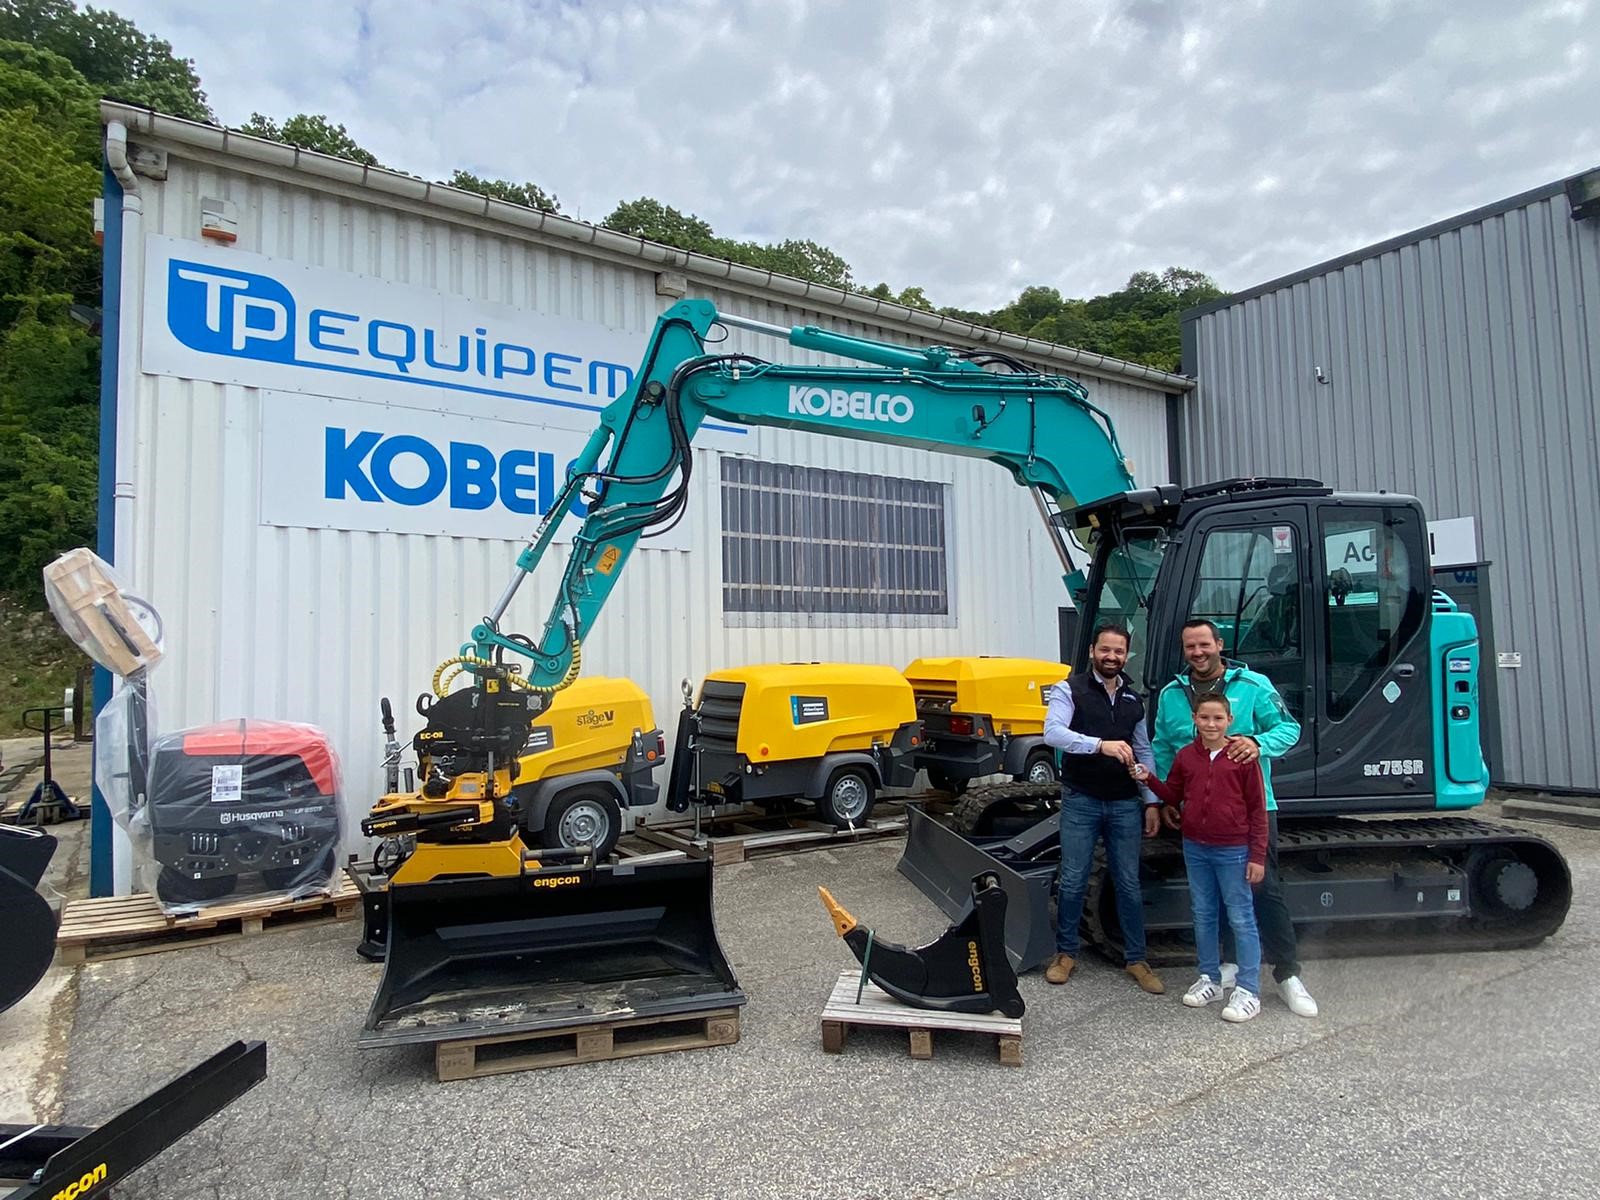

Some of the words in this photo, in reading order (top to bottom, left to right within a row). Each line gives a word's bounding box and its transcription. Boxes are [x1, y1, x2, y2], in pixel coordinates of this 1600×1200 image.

[177, 267, 289, 350] TP
[788, 384, 915, 424] KOBELCO
[1363, 759, 1424, 777] SK75SR
[231, 809, 284, 822] Husqvarna
[373, 821, 397, 829] engcon
[533, 876, 581, 888] engcon
[968, 941, 983, 992] engcon
